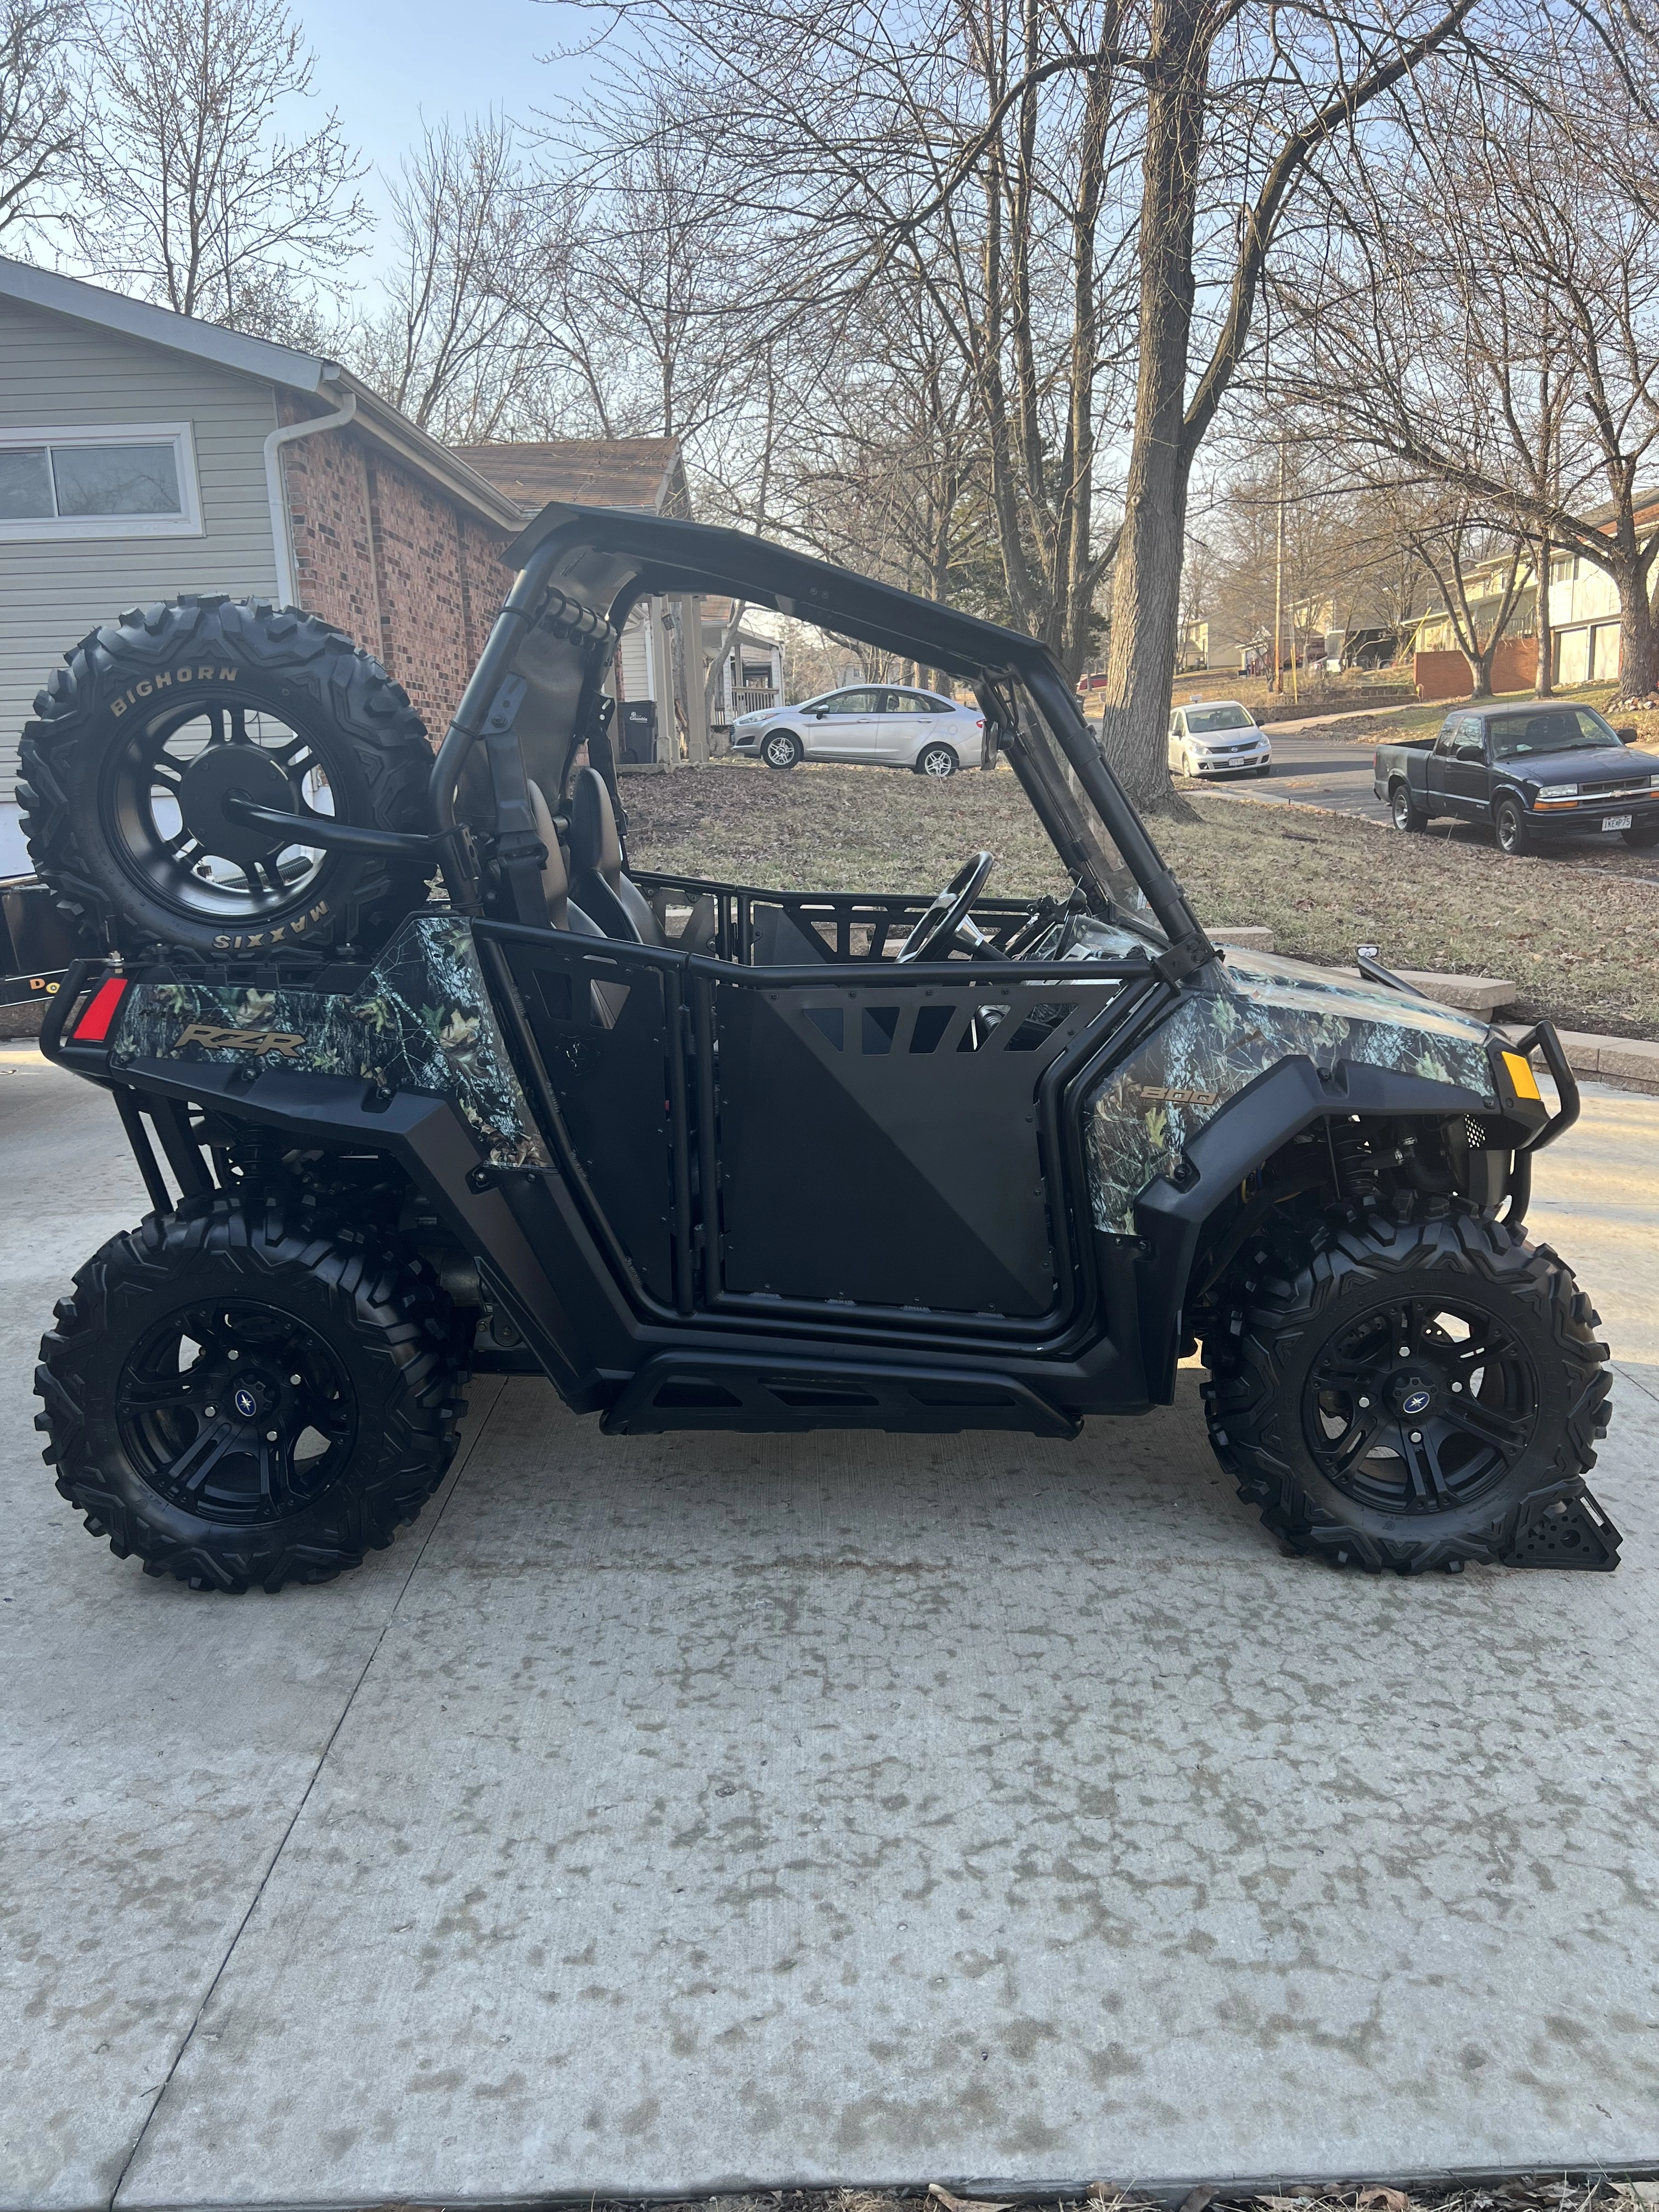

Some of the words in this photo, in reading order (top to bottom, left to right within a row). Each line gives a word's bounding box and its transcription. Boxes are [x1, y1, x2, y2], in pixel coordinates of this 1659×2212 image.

[110, 665, 239, 718] BIGHORN
[1618, 817, 1630, 827] P75
[213, 900, 329, 949] MAXXIS
[174, 1024, 306, 1058] RZR
[1140, 1085, 1218, 1105] 800
